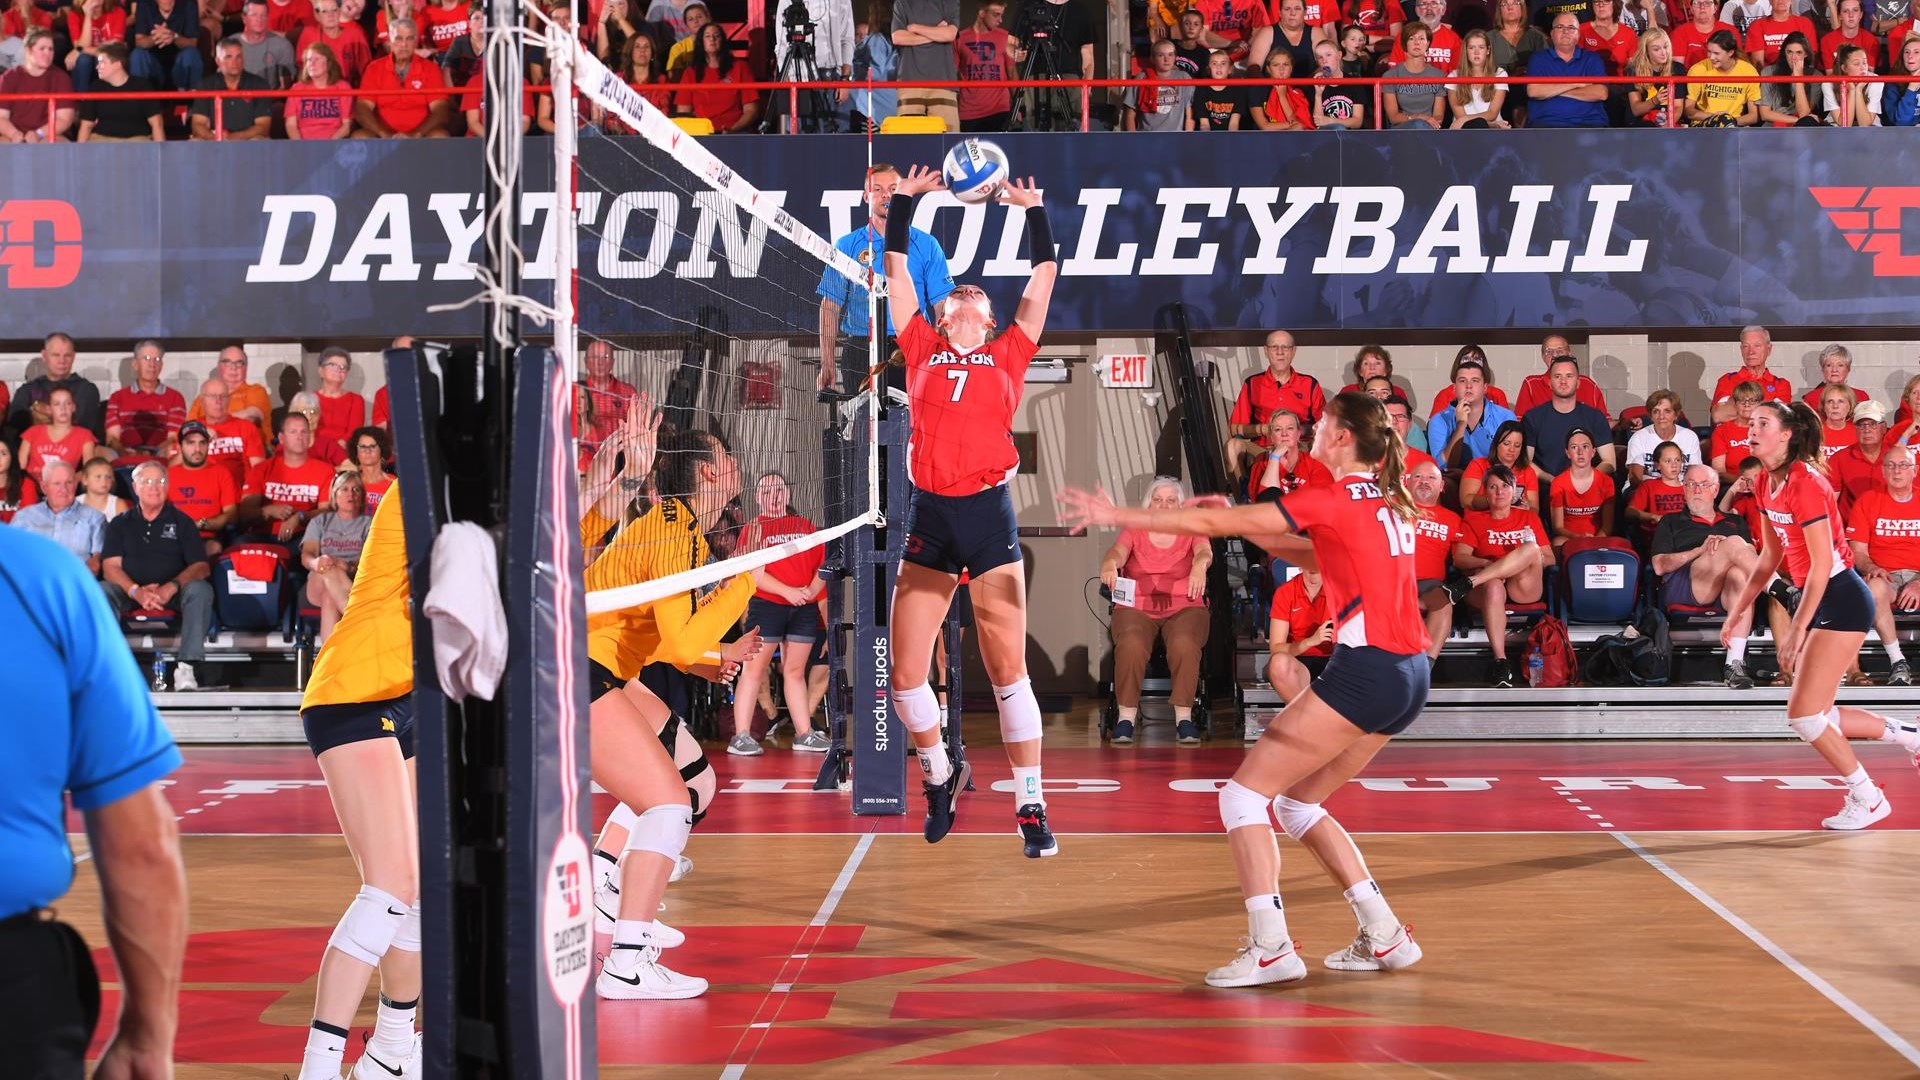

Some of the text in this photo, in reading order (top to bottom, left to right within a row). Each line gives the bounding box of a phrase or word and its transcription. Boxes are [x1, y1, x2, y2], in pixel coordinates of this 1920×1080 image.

[1546, 2, 1587, 13] MICHIGAN
[1704, 84, 1743, 94] MICHIGAN
[301, 99, 340, 110] FIRE
[245, 191, 788, 283] DAYTON
[928, 350, 996, 367] DAYTON
[1111, 356, 1147, 383] EXIT
[946, 369, 970, 402] 7
[208, 437, 243, 450] YERS
[1729, 439, 1751, 447] DAY
[265, 482, 319, 496] FLYERS
[1655, 503, 1685, 511] FLYE
[1876, 518, 1920, 530] FLYER
[1376, 506, 1416, 557] 16
[1487, 529, 1524, 539] FLYER
[1876, 530, 1907, 538] WEAR
[872, 637, 889, 687] sports
[554, 923, 586, 952] DAYTON
[556, 948, 587, 977] FLYERS
